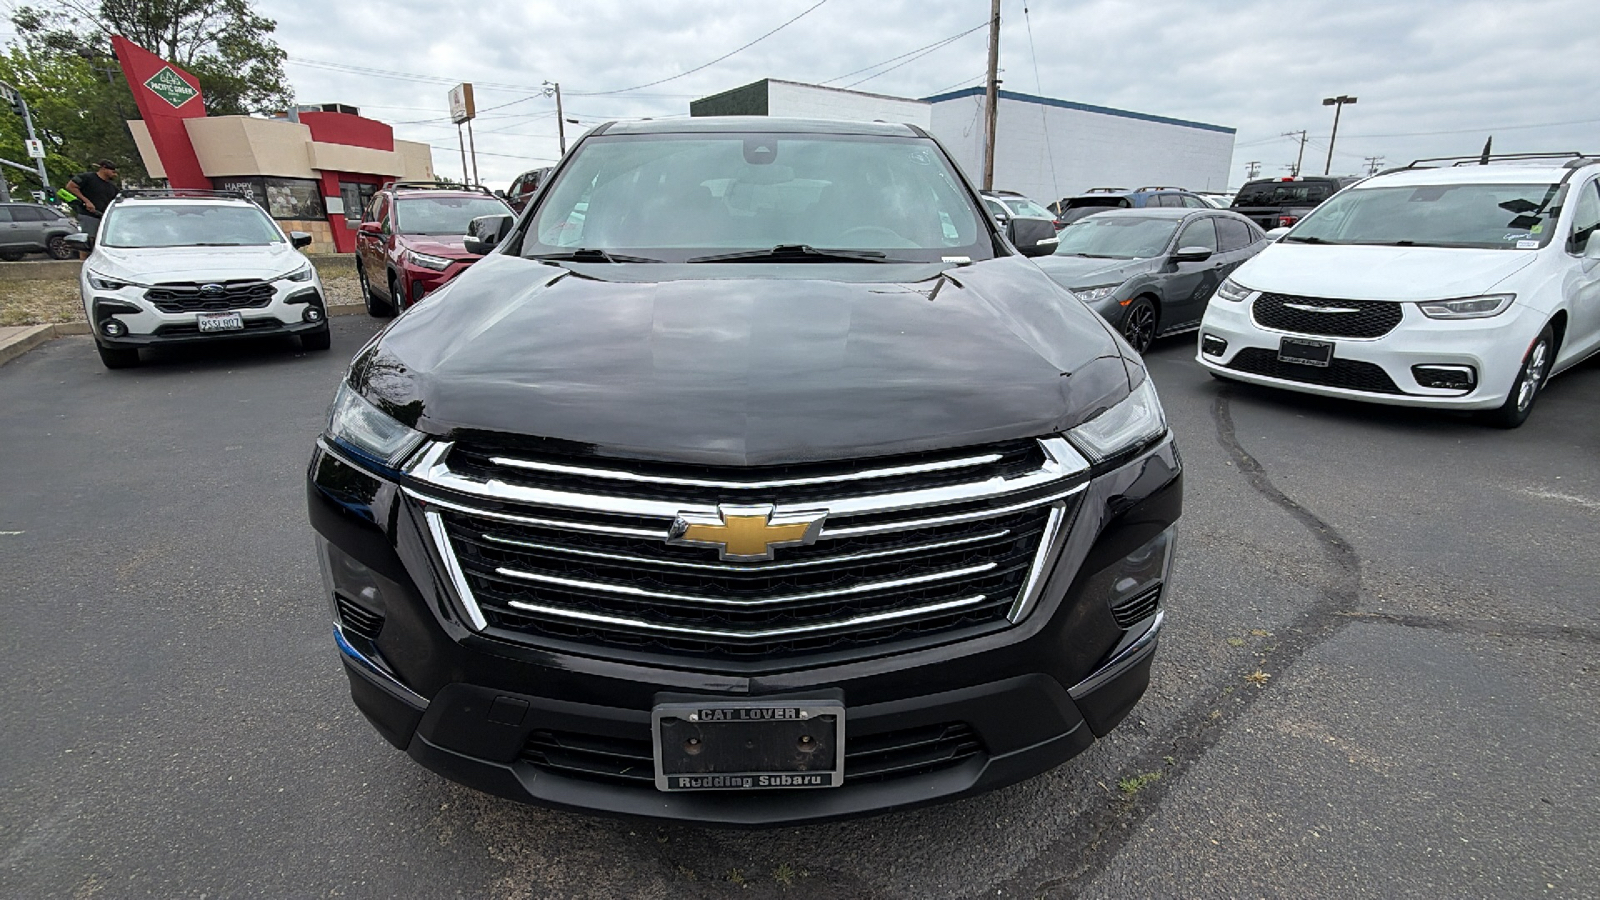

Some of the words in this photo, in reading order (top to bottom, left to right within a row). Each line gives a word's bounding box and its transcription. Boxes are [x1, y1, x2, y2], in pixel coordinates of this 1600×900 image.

[151, 81, 174, 92] PACIFIC
[224, 182, 252, 191] HAPPY
[701, 708, 735, 721] CAT
[739, 707, 796, 720] LOVER
[678, 775, 753, 788] Redding
[758, 774, 822, 786] Subaru
